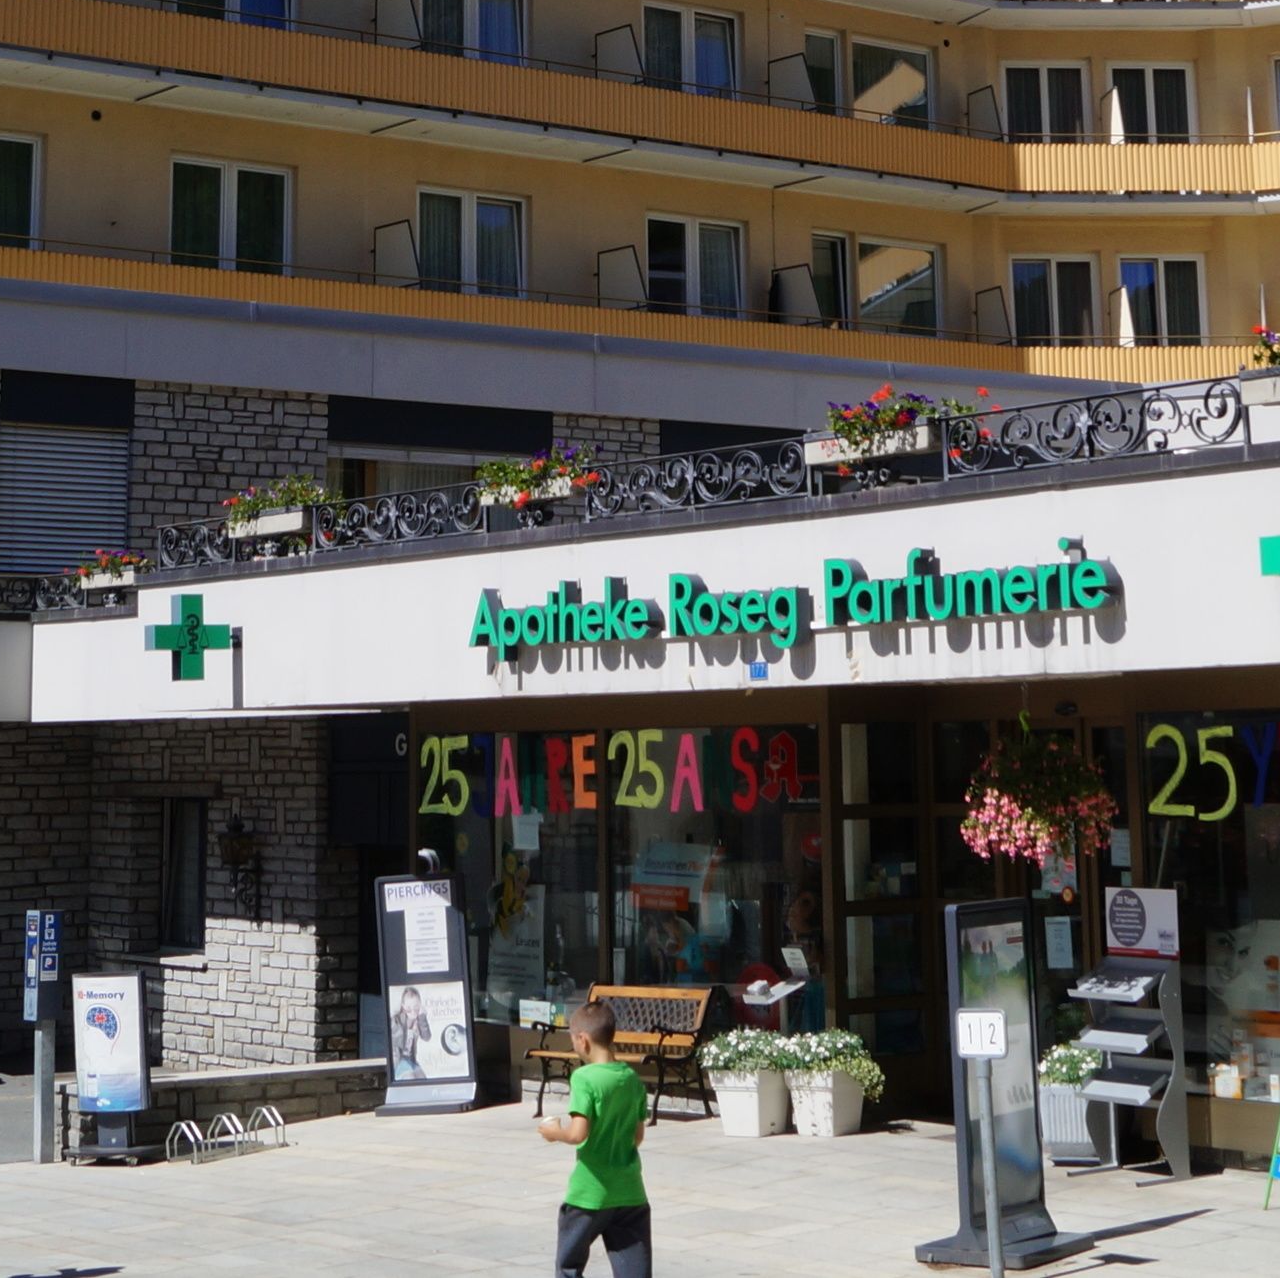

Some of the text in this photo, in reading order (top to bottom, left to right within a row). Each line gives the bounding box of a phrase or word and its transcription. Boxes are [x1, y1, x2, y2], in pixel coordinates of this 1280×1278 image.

[469, 537, 1108, 661] Apotheke Roseg Parfumerie
[751, 663, 765, 677] 177
[419, 734, 470, 817] 25
[472, 733, 598, 818] JAHRE
[607, 728, 665, 809] 25
[1145, 722, 1237, 822] 25
[387, 882, 449, 899] PIERCINGS
[967, 1022, 997, 1045] 1 2
